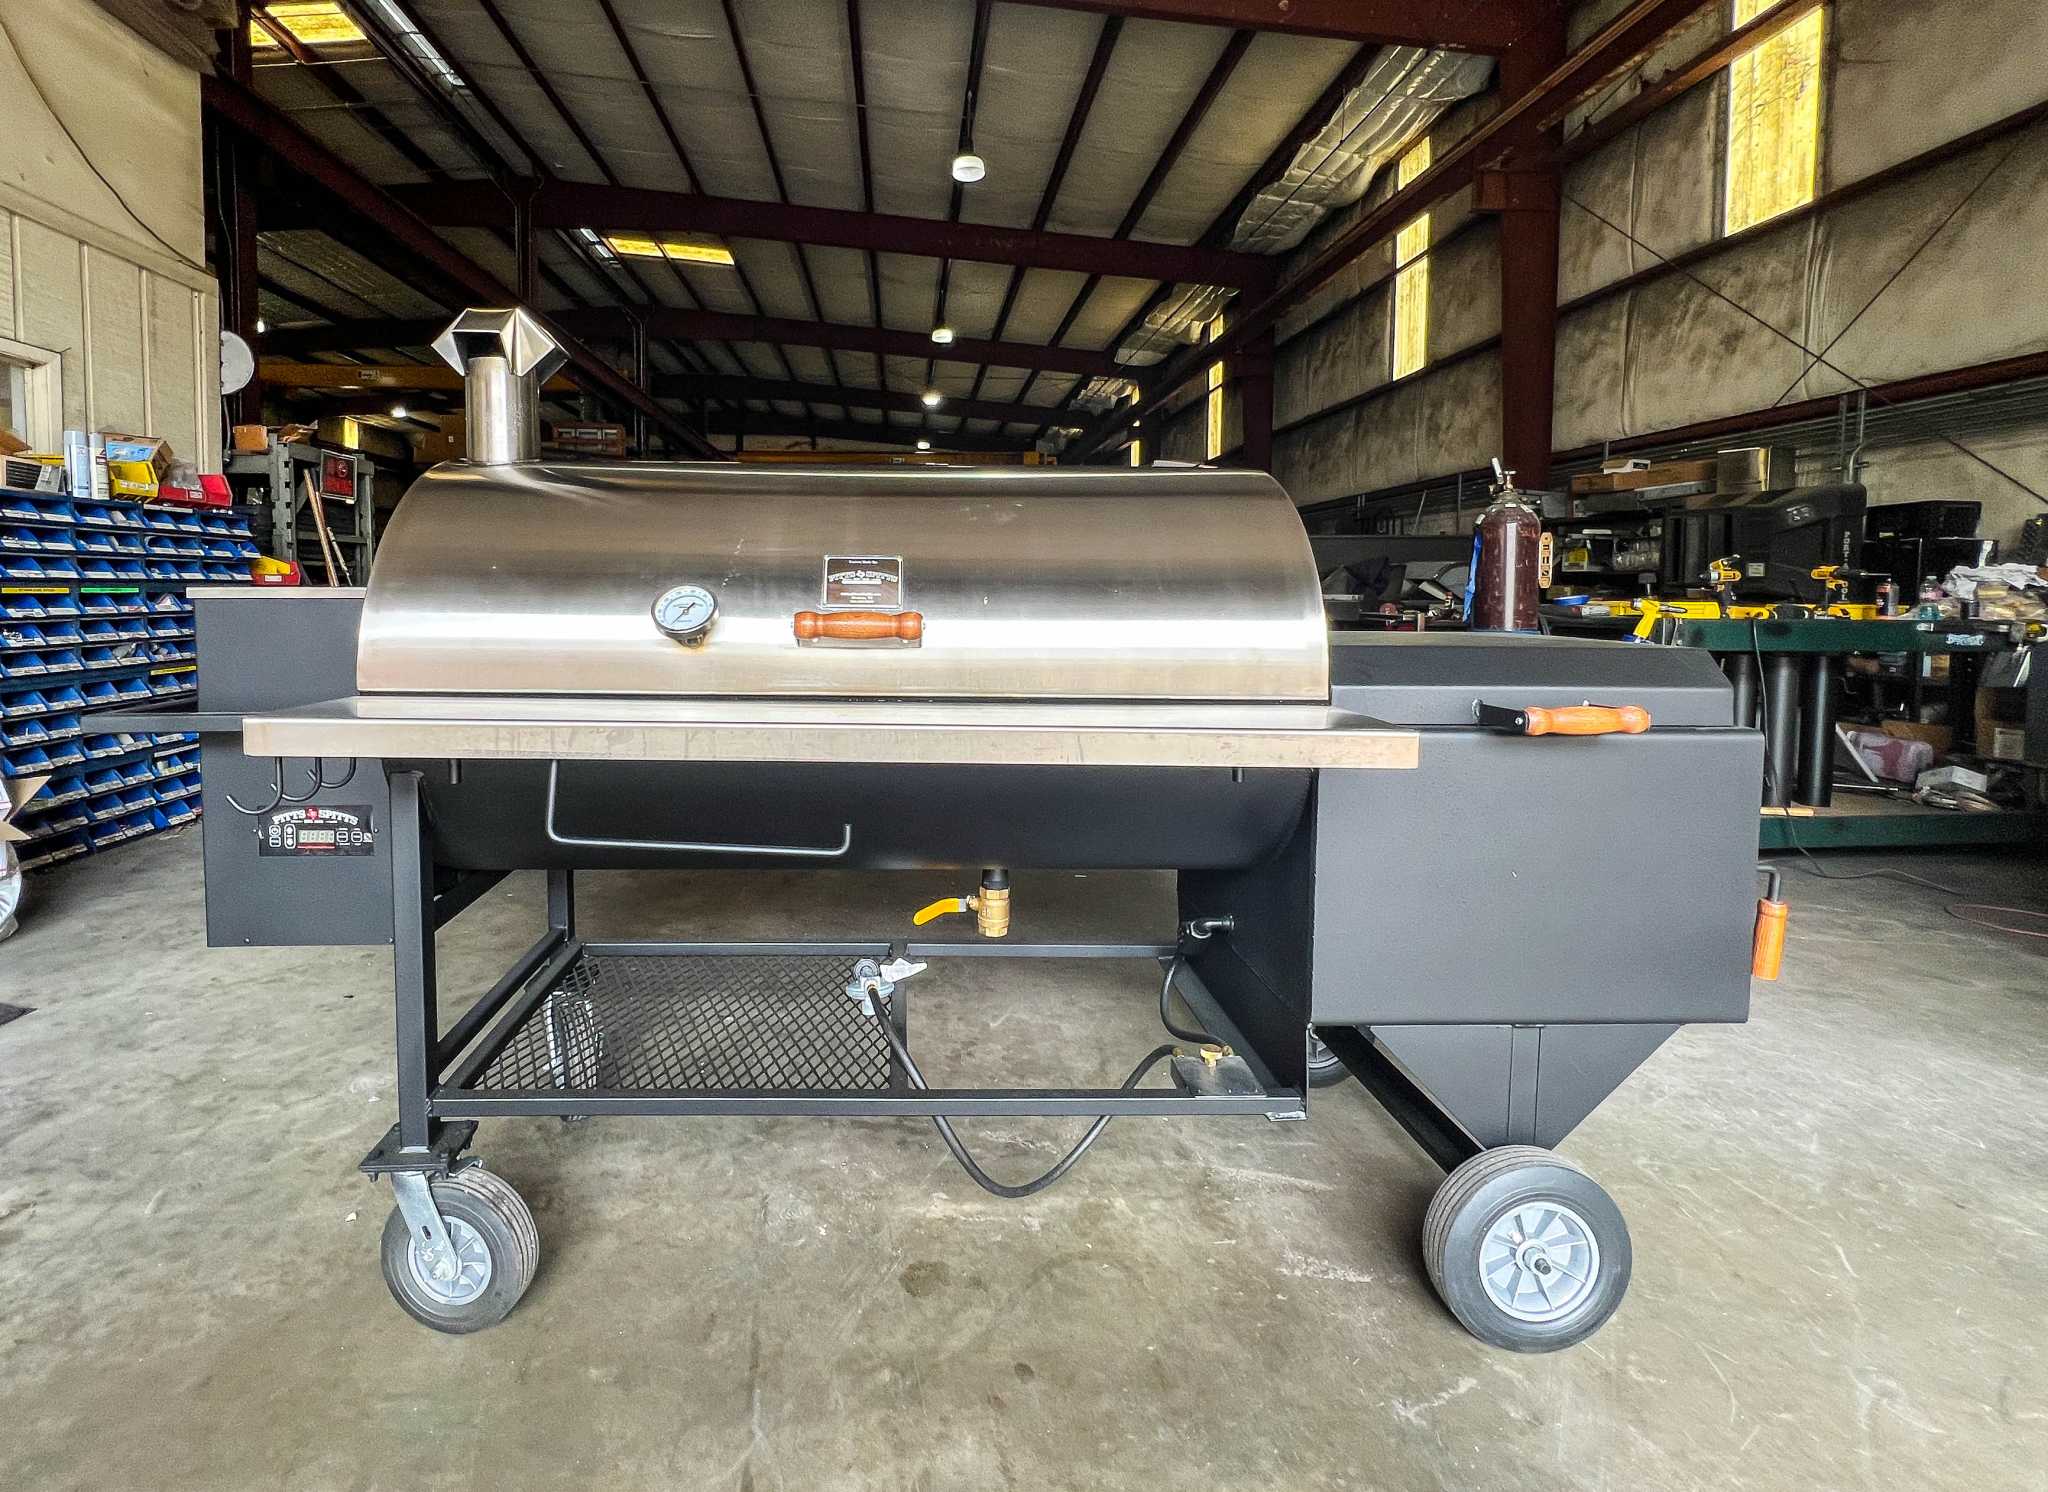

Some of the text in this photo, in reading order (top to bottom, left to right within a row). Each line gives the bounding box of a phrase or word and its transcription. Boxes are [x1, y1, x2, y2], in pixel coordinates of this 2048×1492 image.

[1841, 531, 1851, 600] PORT-AOOL
[272, 809, 359, 825] PITTS SPITTS
